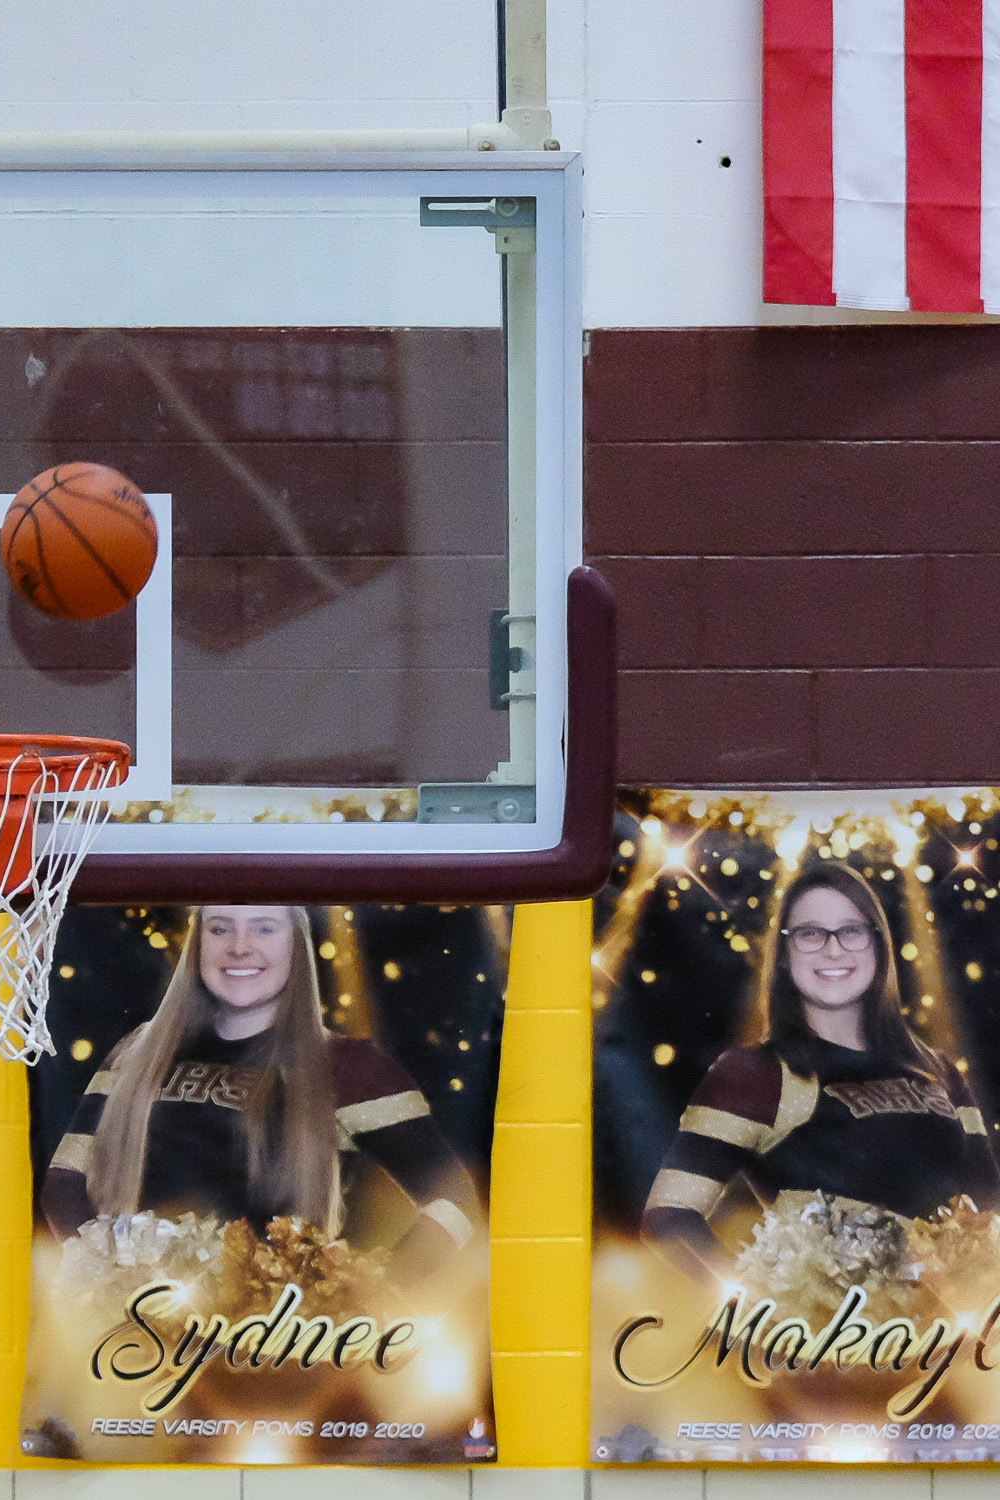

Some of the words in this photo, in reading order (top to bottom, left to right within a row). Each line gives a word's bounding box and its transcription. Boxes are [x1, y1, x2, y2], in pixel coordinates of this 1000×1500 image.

[90, 1284, 416, 1413] Sydnee
[91, 1418, 155, 1435] REESE
[163, 1419, 248, 1437] VARSITY
[251, 1420, 315, 1437] POMS
[320, 1421, 368, 1438] 2019
[374, 1422, 426, 1439] 2020
[677, 1423, 742, 1440] REESE
[750, 1423, 834, 1440] VARSITY
[840, 1423, 900, 1440] POMS
[906, 1423, 956, 1440] 2019
